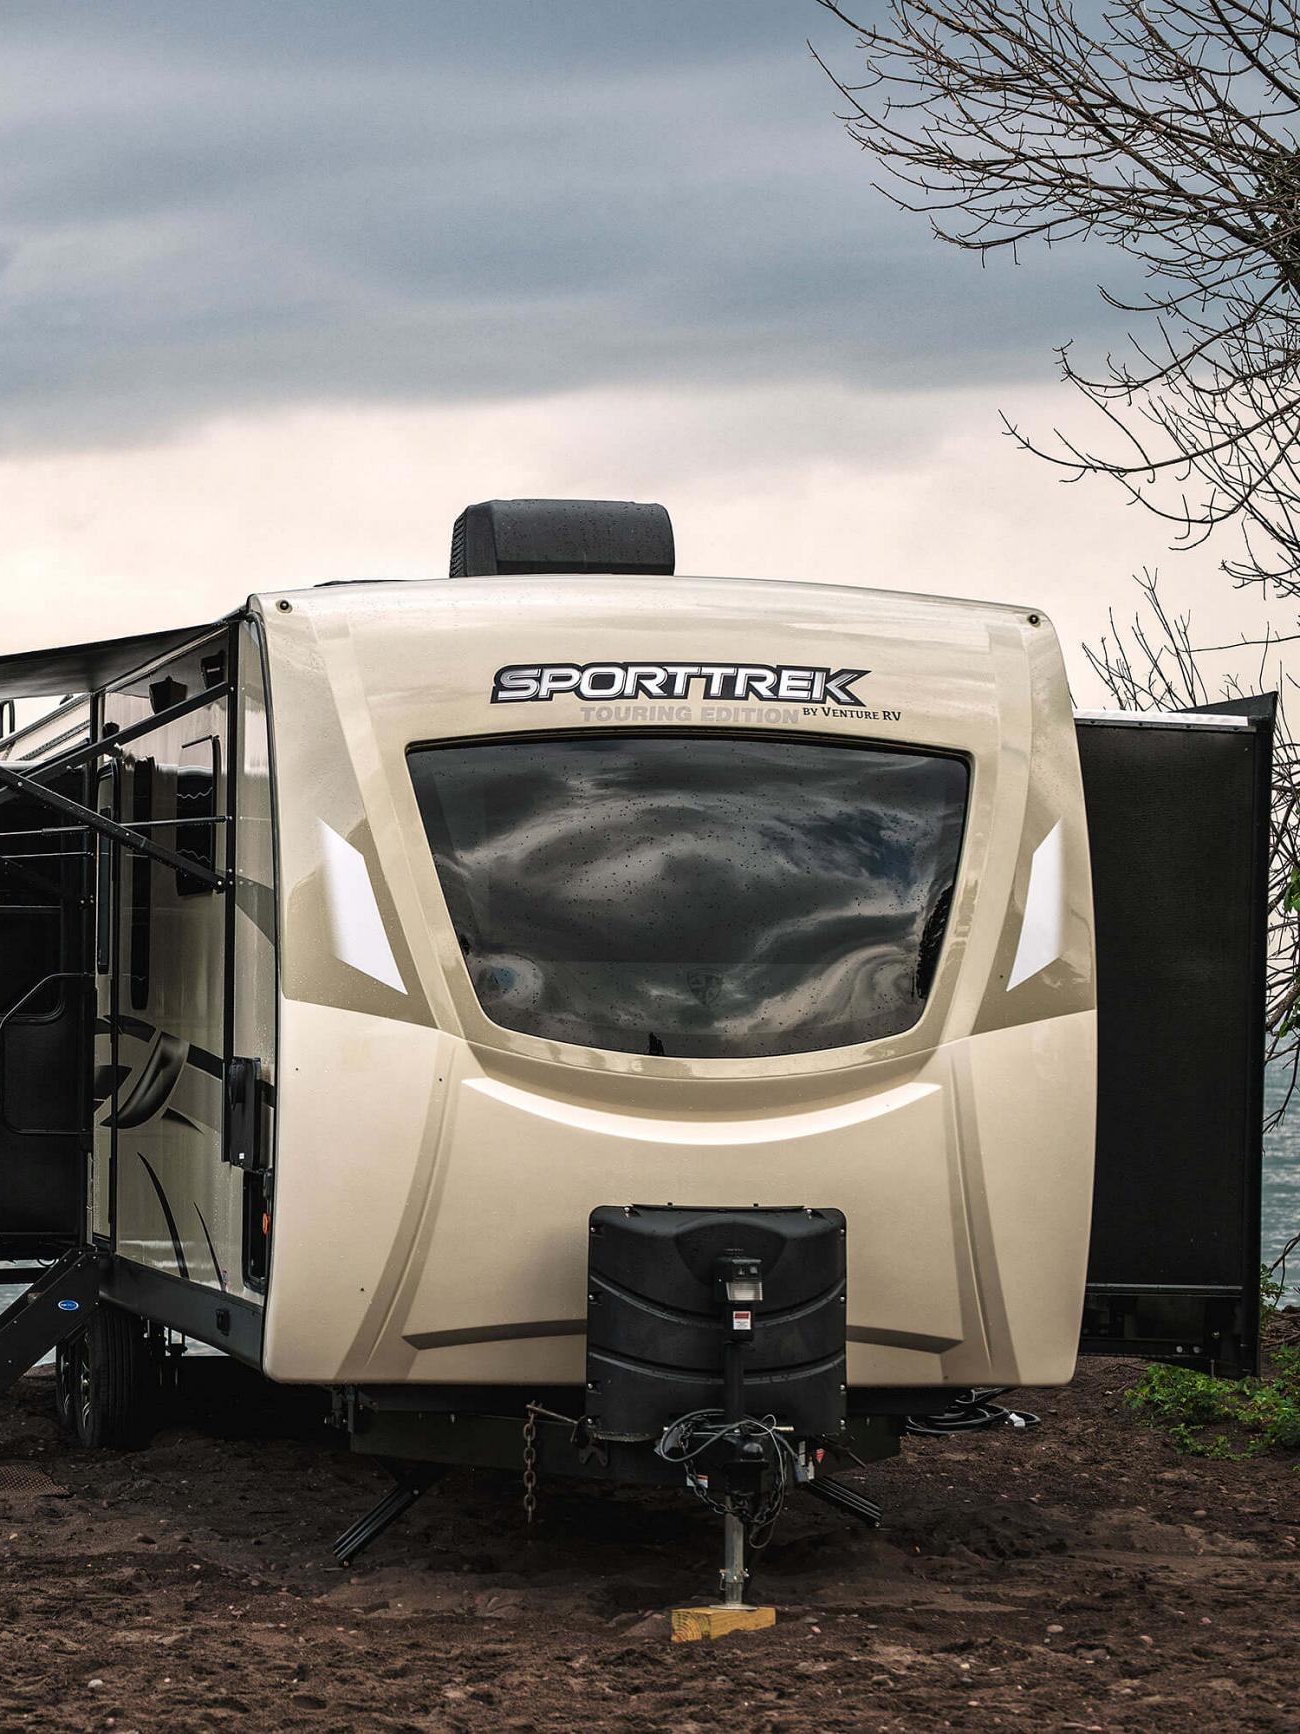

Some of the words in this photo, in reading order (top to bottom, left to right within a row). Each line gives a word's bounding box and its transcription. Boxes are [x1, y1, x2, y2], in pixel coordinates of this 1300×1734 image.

[492, 662, 868, 705] SPORTTREK
[580, 705, 692, 722] TOURING
[700, 706, 799, 724] EDITION
[803, 707, 818, 717] BY
[821, 707, 879, 720] VENTURE
[883, 710, 901, 722] RV
